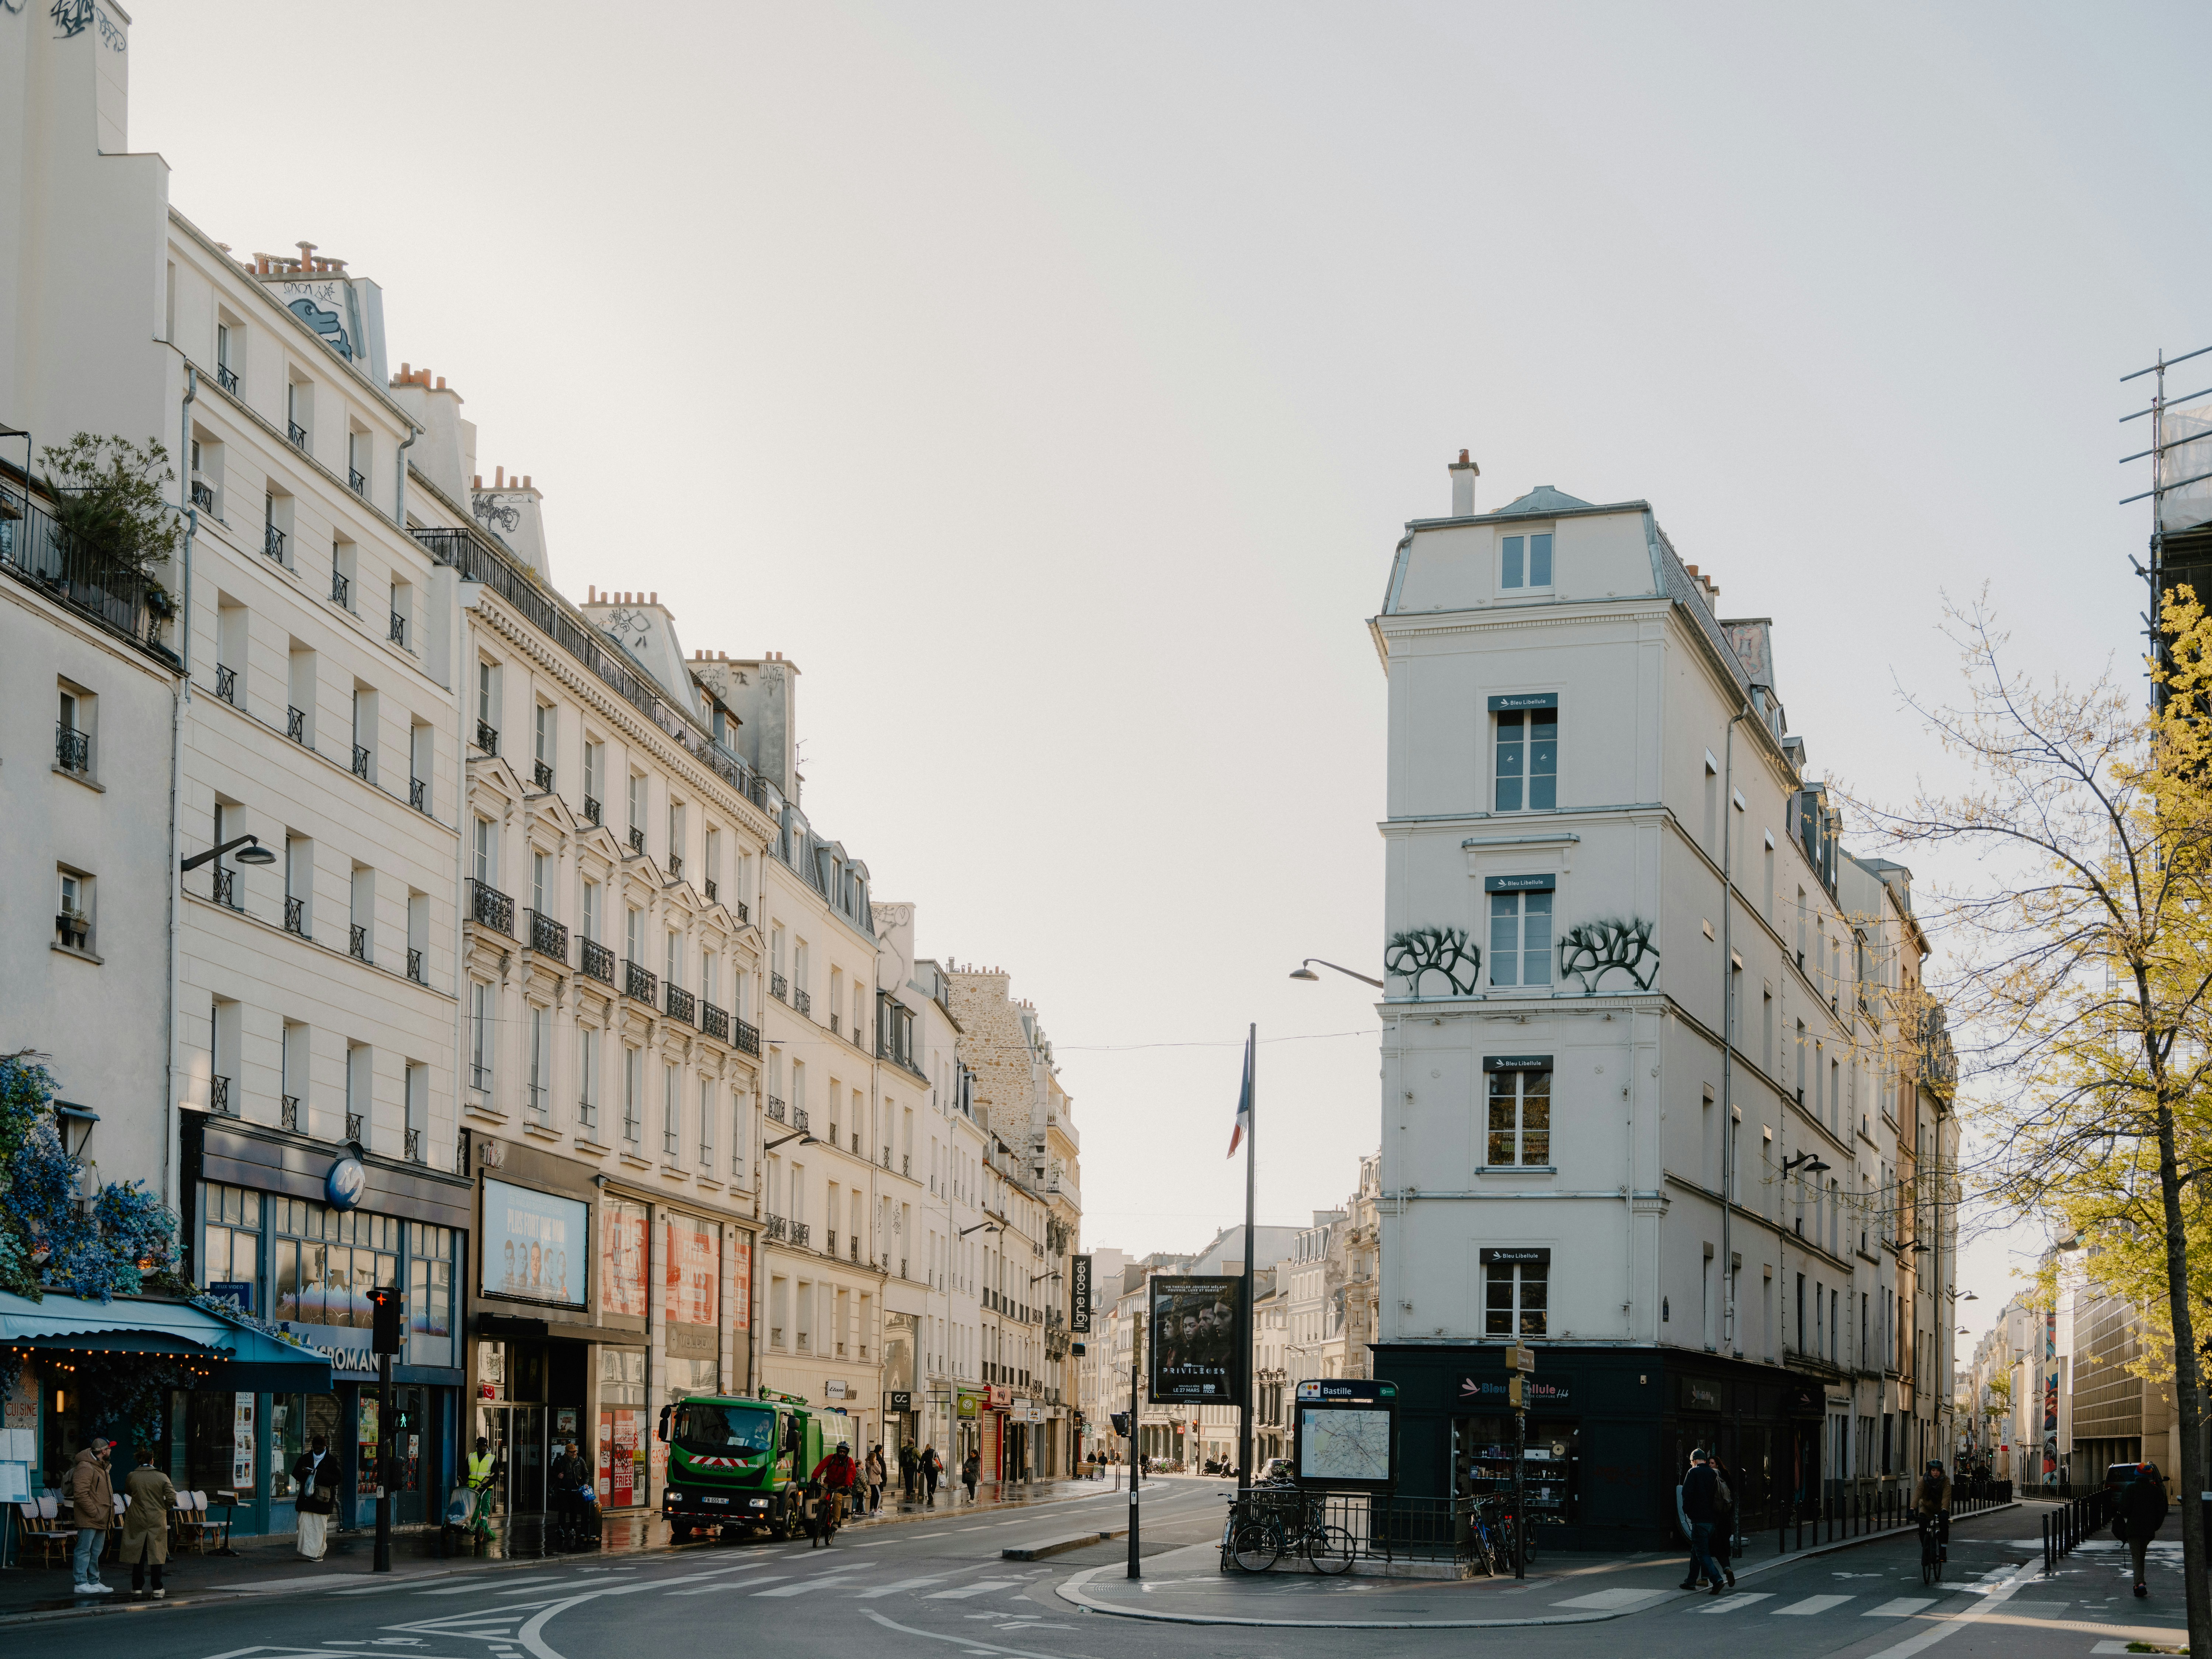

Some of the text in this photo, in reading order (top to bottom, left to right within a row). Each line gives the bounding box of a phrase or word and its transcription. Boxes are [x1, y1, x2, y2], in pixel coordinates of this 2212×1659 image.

[482, 1141, 504, 1168] mk2
[507, 1208, 564, 1245] PLUS FORT QUE MOI
[613, 1222, 642, 1252] THE
[684, 1239, 704, 1262] FIVE
[680, 1262, 706, 1285] GUYS
[685, 1290, 701, 1299] BASTILLE
[1074, 1261, 1088, 1327] ligne roset
[680, 1334, 714, 1350] VOLCOM
[1482, 1383, 1506, 1393] Bleu
[1557, 1389, 1569, 1399] Hub
[4, 1402, 37, 1416] CUISINE
[651, 1448, 664, 1464] GAZA
[702, 1464, 734, 1473] IVECO
[615, 1475, 632, 1487] FRIES
